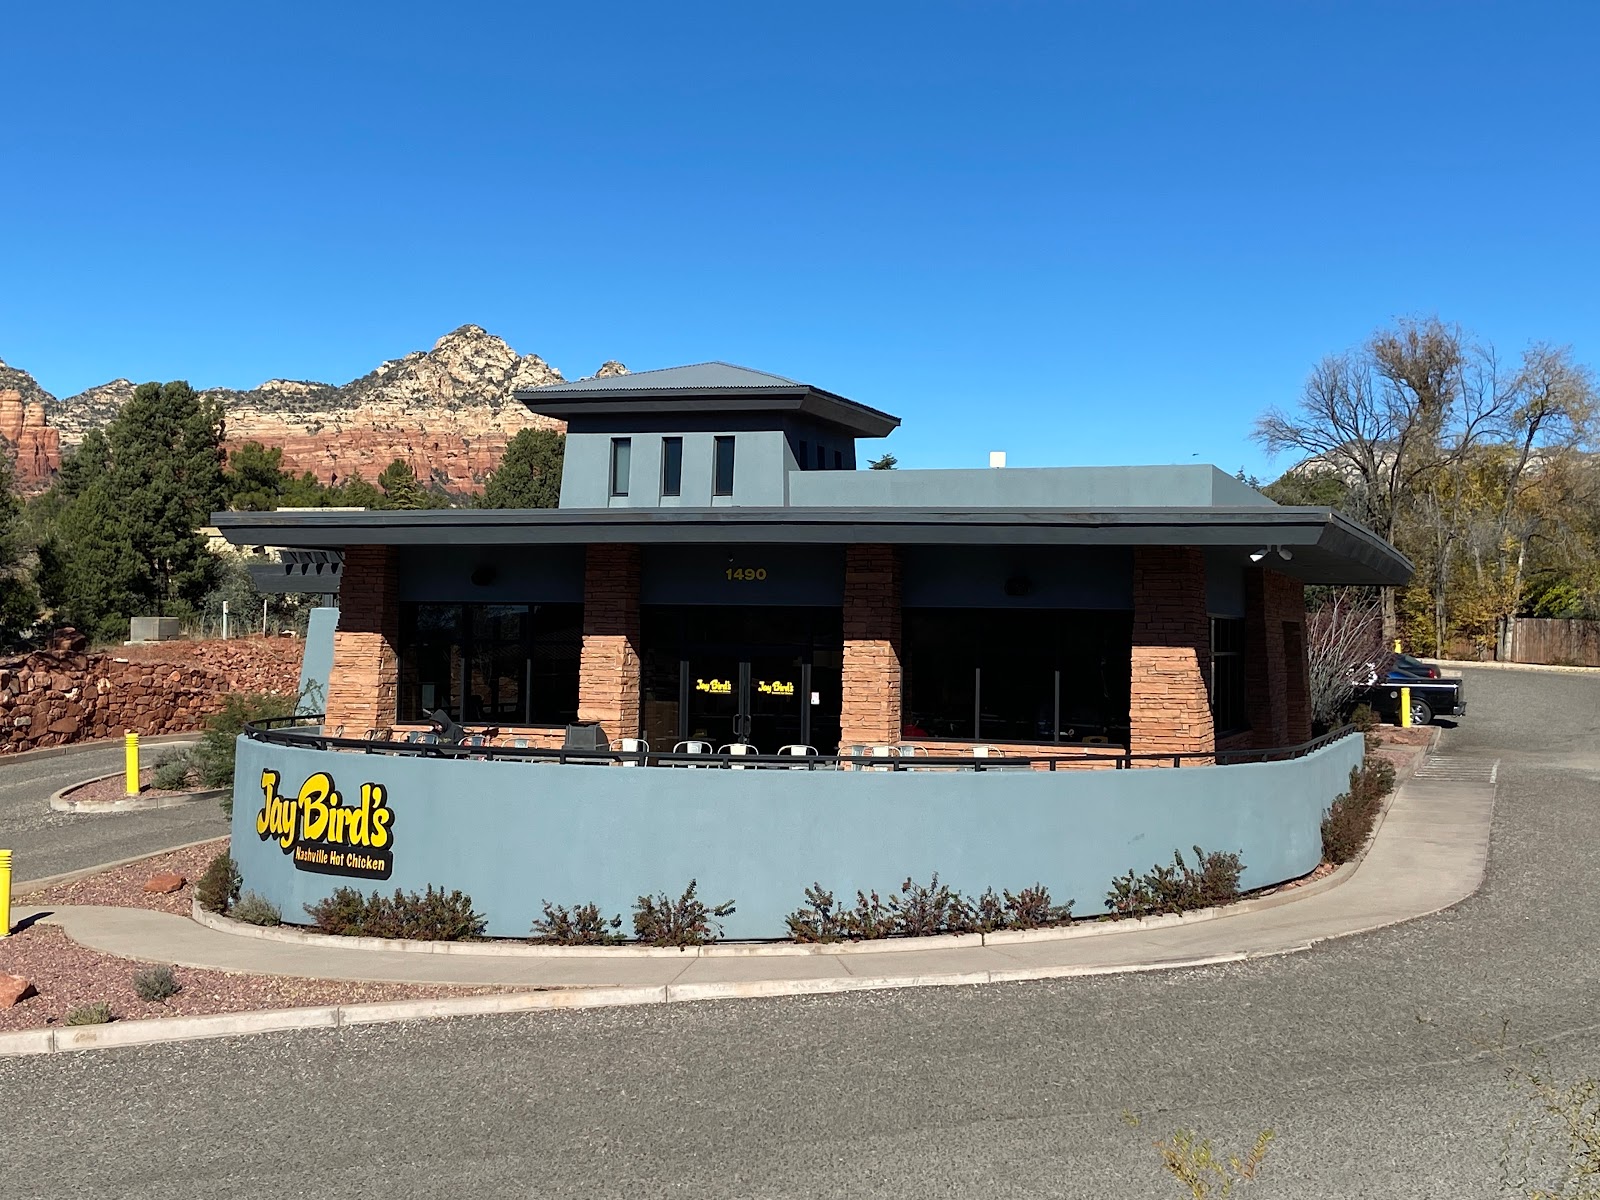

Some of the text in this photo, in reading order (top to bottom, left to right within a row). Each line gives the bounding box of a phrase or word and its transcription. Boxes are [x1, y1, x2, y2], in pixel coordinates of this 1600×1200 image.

[725, 568, 767, 581] 1490
[696, 679, 710, 692] Jay
[758, 681, 772, 694] Jay
[256, 771, 391, 849] Jay Bird's
[295, 846, 385, 871] Nashville Hot Chicken
